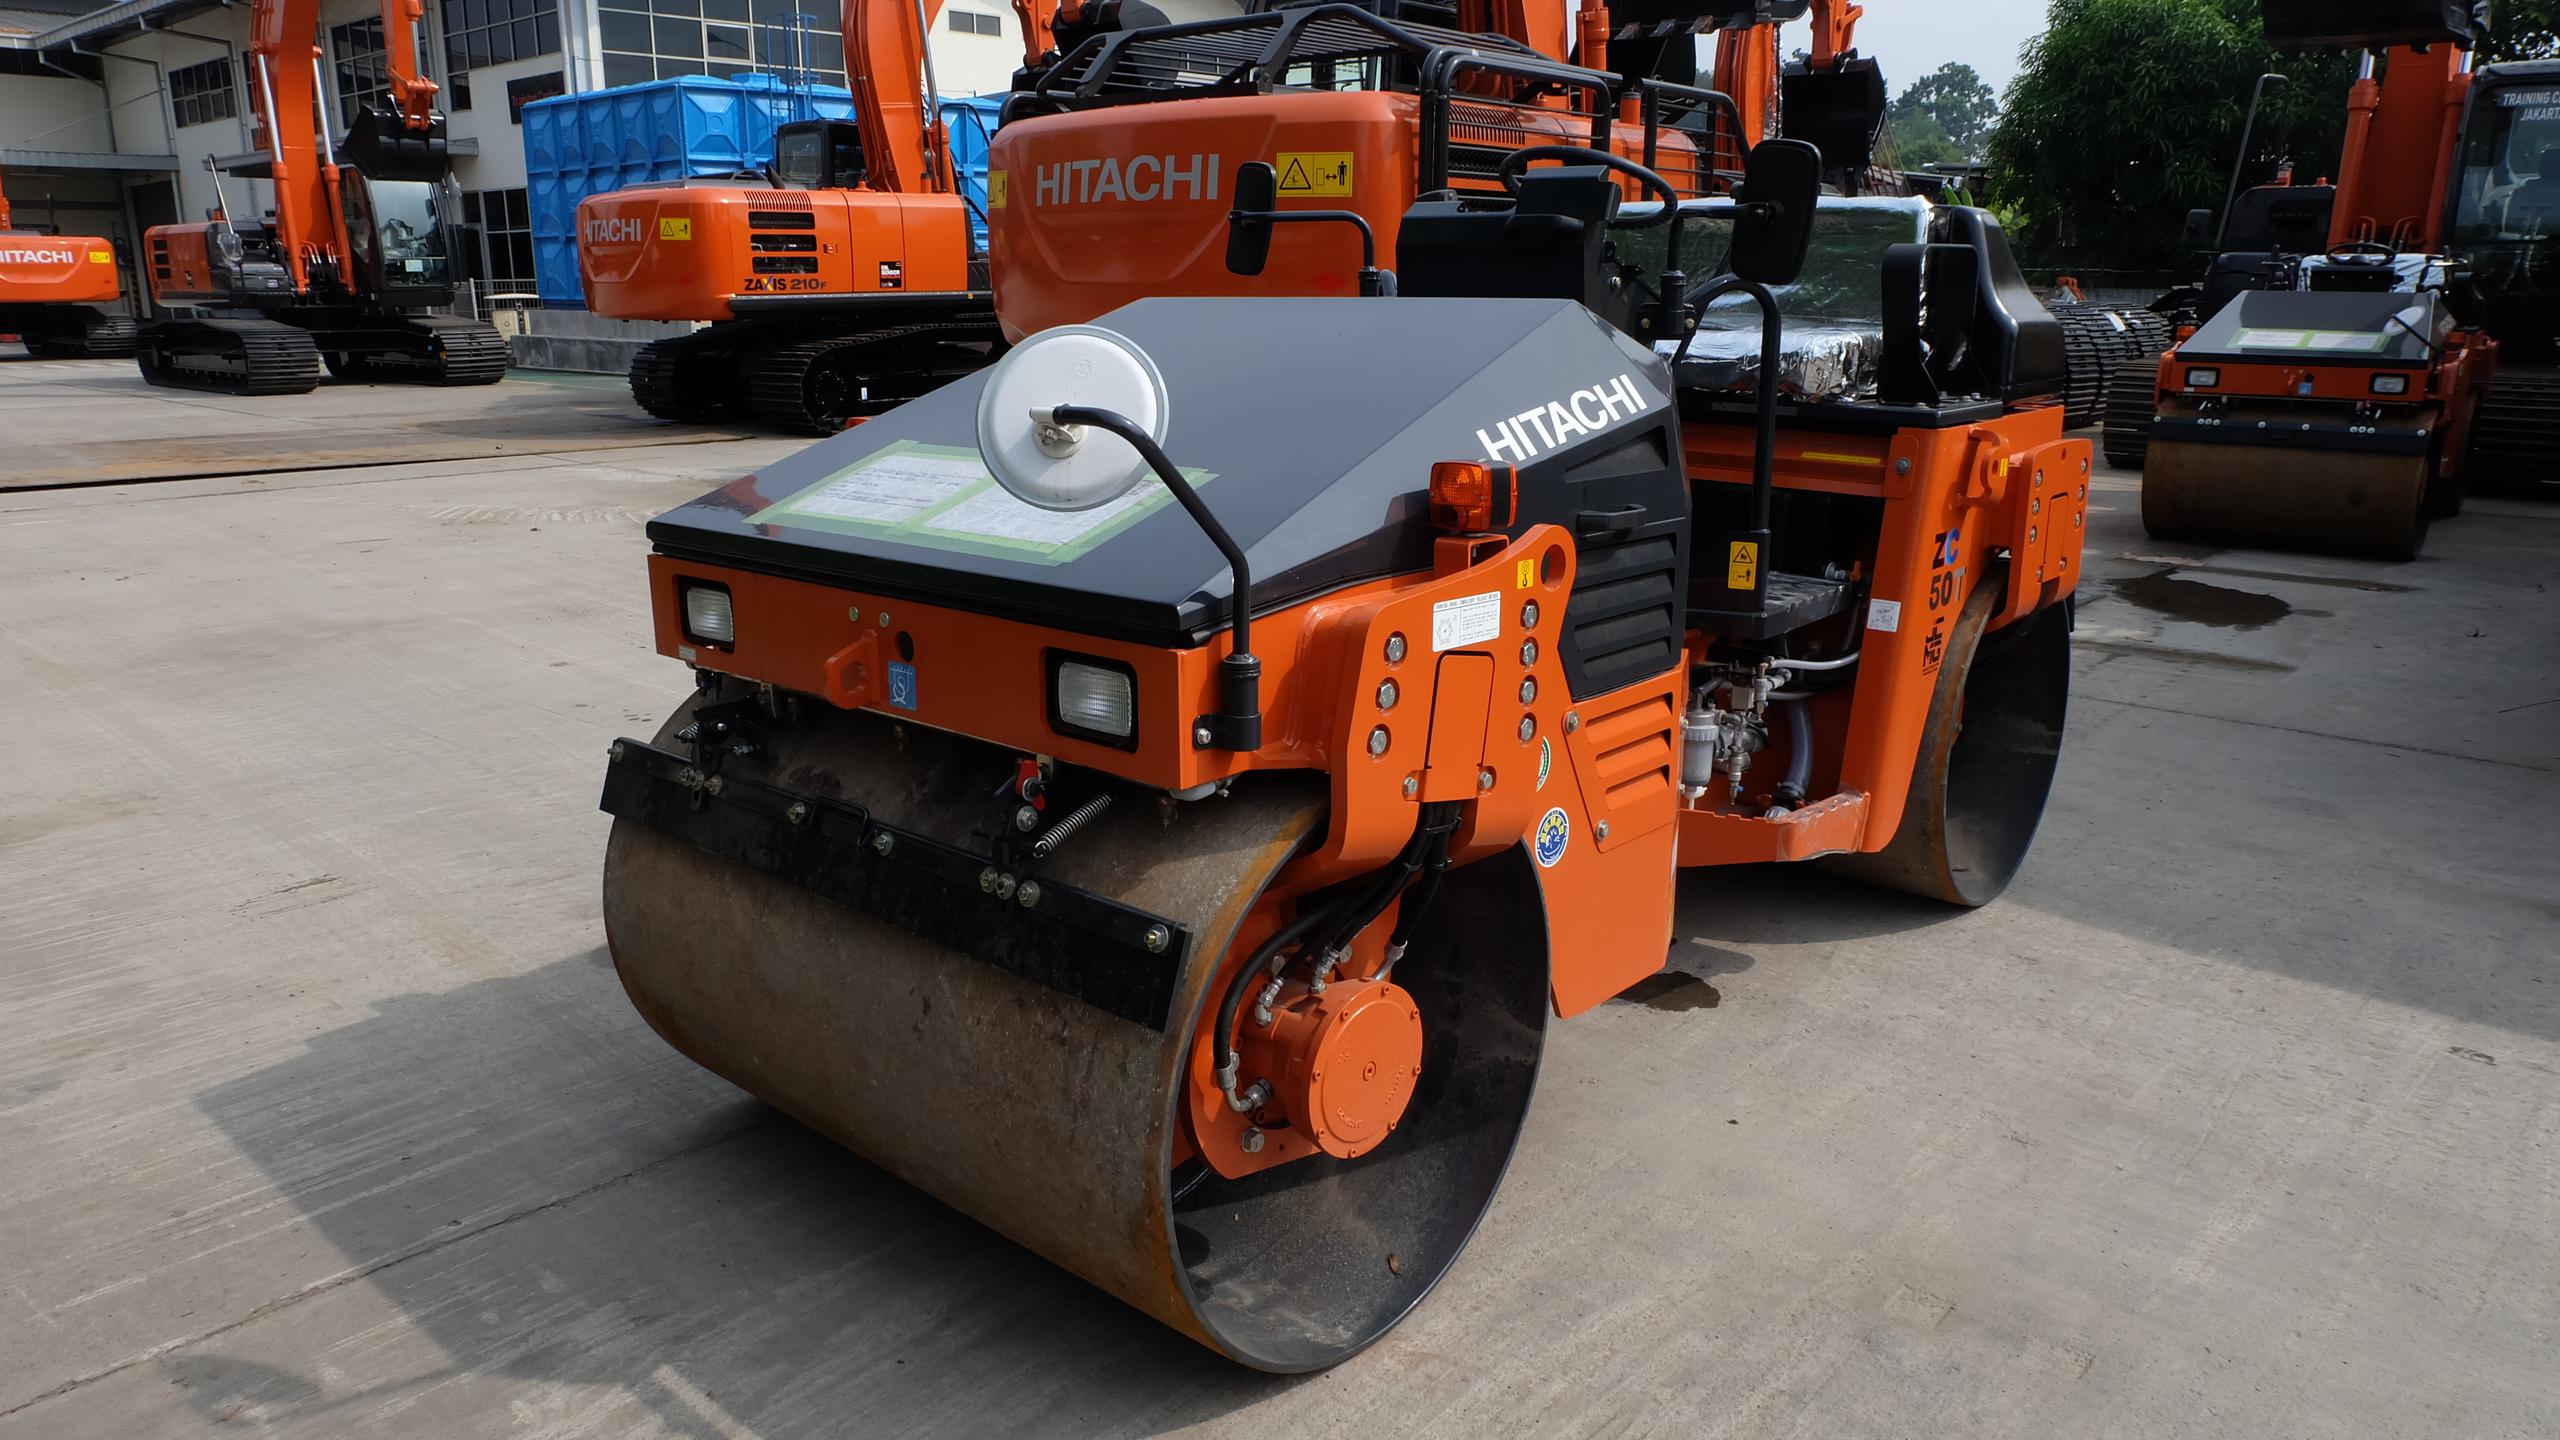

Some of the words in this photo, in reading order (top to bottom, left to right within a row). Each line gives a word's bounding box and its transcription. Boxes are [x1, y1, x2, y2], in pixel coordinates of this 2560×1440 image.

[2503, 91, 2550, 106] TRAINING
[2520, 107, 2560, 121] JAKART
[1036, 153, 1220, 207] HITACHI
[744, 276, 787, 292] ZAXIS
[790, 278, 827, 290] 210F
[1476, 374, 1648, 462] HITACHI
[1932, 528, 1960, 570] ZC
[1929, 566, 1968, 610] 50T
